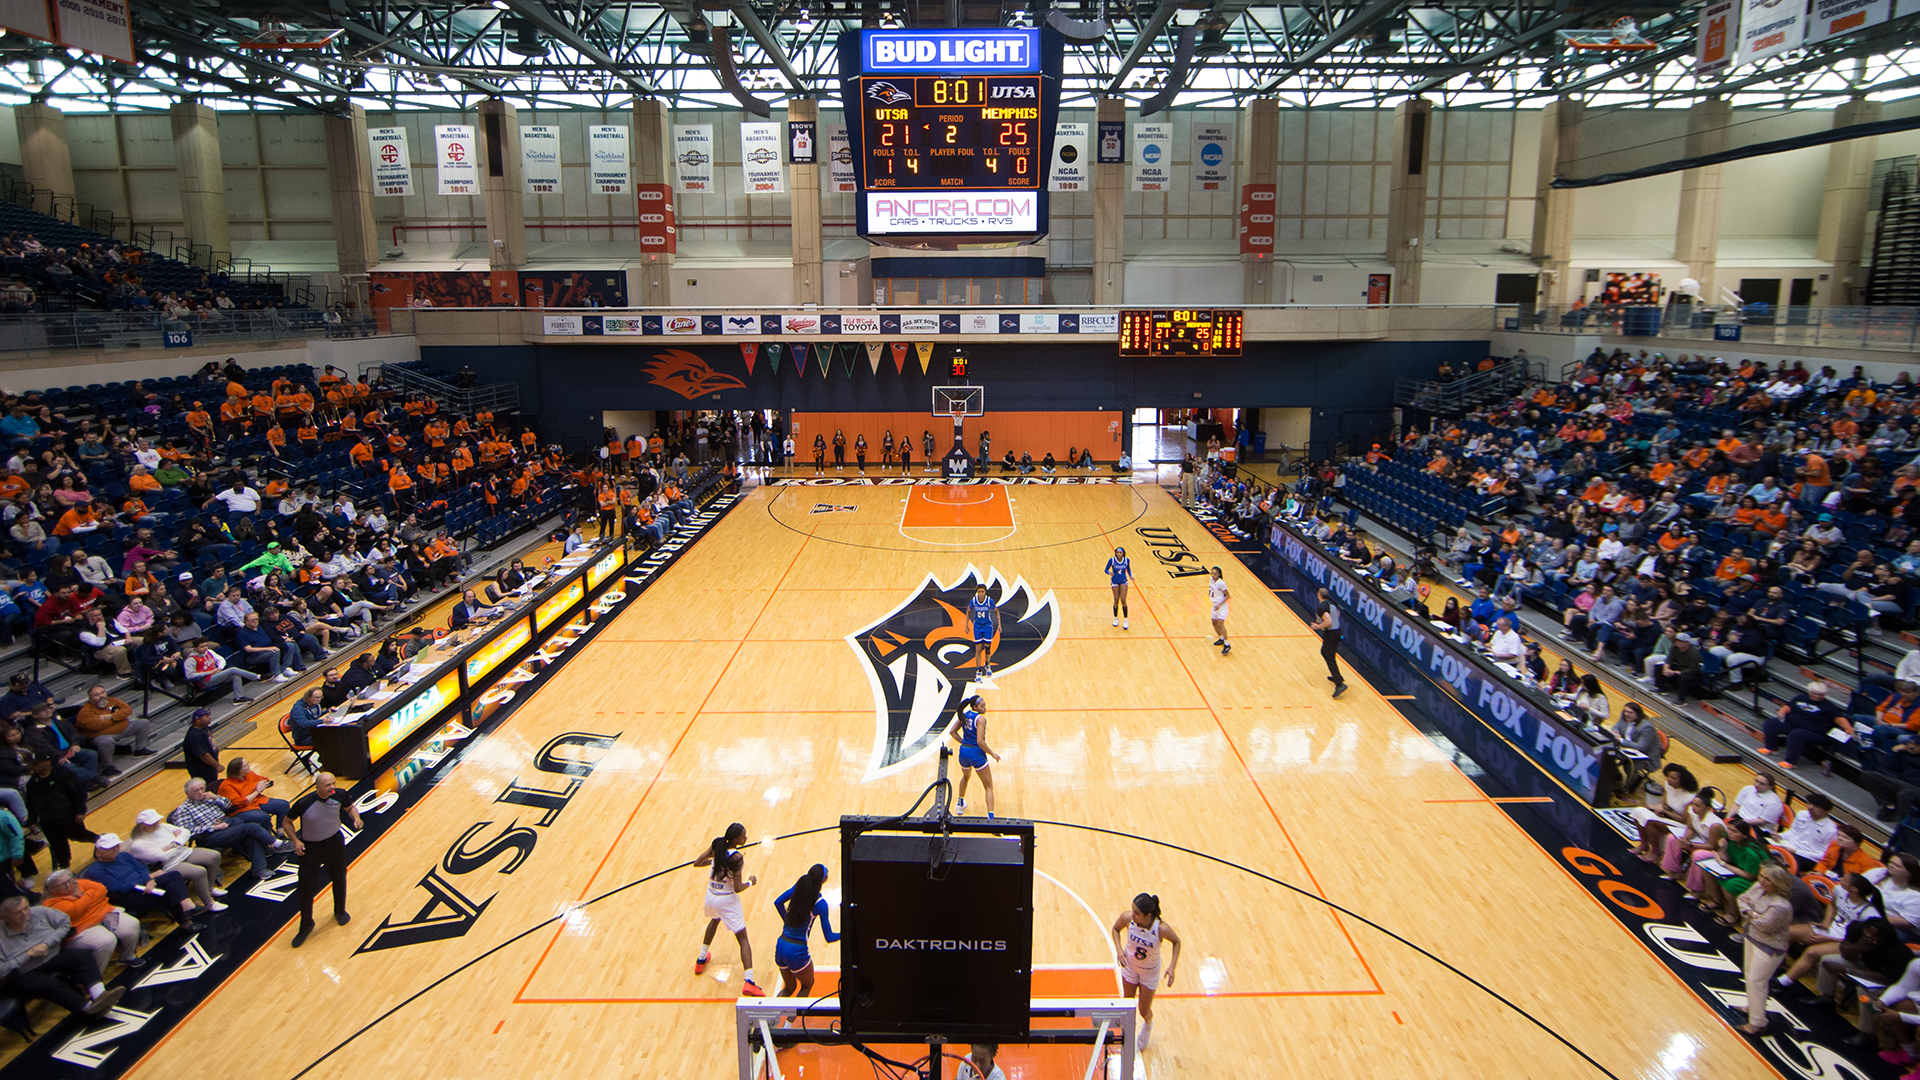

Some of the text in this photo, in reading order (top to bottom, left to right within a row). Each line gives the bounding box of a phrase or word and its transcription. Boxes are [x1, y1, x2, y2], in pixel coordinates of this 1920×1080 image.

[83, 6, 104, 20] 2010
[107, 14, 126, 27] 2013
[1747, 16, 1796, 39] CHAMPIONS
[876, 40, 936, 62] BUD
[934, 80, 983, 103] 8:01
[991, 86, 1036, 98] UTSA
[876, 109, 908, 120] UTSA
[939, 115, 963, 123] PERIOD
[982, 108, 1037, 120] MEMPHIS
[881, 124, 909, 146] 21
[946, 125, 957, 143] 2
[1000, 123, 1028, 146] 25
[874, 149, 894, 157] FOULS
[958, 148, 974, 156] FOUL
[888, 159, 892, 174] 1
[907, 159, 918, 174] 4
[986, 158, 996, 173] 4
[1017, 157, 1027, 174] 0
[941, 178, 963, 186] MATCH
[876, 199, 1030, 217] ANCIRA.COM
[606, 319, 639, 328] BEATBOX
[1174, 311, 1196, 321] 8:01
[169, 335, 188, 344] 106
[1155, 328, 1169, 338] 21
[1178, 329, 1184, 338] 2
[1196, 328, 1209, 339] 25
[1203, 342, 1209, 350] 0
[953, 365, 965, 375] 30
[771, 477, 1144, 486] ROADRUNNERS
[709, 492, 741, 511] THE
[622, 511, 721, 585] UNIVERSITY
[1135, 526, 1211, 579] UTSA
[587, 591, 627, 615] OF
[478, 621, 596, 707] TEXAS
[1285, 537, 1303, 565] FOX
[1305, 552, 1327, 584] FOX
[1329, 570, 1354, 606] FOX
[1357, 591, 1386, 631] FOX
[1390, 616, 1425, 661] FOX
[1430, 645, 1472, 696] FOX
[1478, 679, 1527, 738] FOX
[1536, 721, 1598, 790] FOX
[390, 683, 442, 733] UTSA
[349, 731, 623, 959] UTSA
[875, 938, 1007, 951] DAKTRONICS
[1130, 933, 1154, 948] UTSA
[1134, 946, 1148, 960] 8
